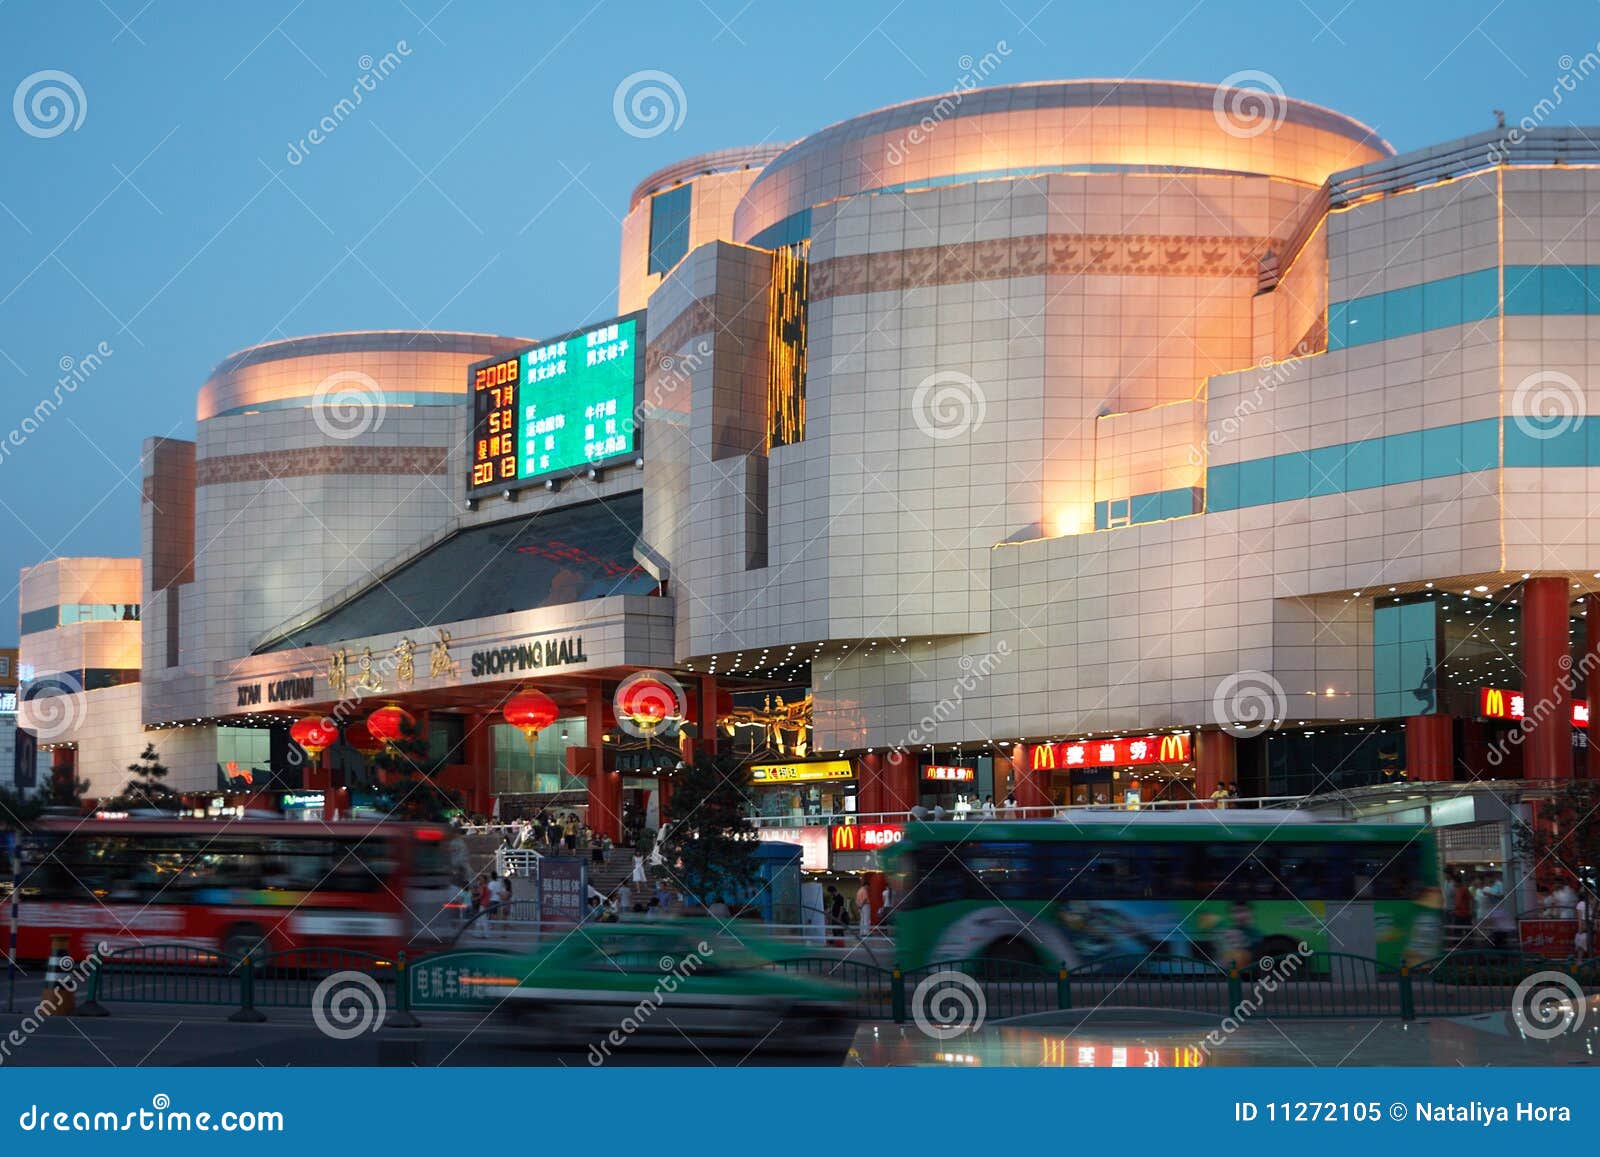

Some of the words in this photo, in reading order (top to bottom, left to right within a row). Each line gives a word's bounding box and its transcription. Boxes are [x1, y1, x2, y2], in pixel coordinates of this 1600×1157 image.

[475, 359, 518, 391] 2008
[473, 462, 493, 486] 20
[472, 641, 543, 677] SHOPPING
[545, 636, 588, 667] MALL
[1066, 740, 1148, 765] 麦当劳
[865, 829, 905, 844] McDo
